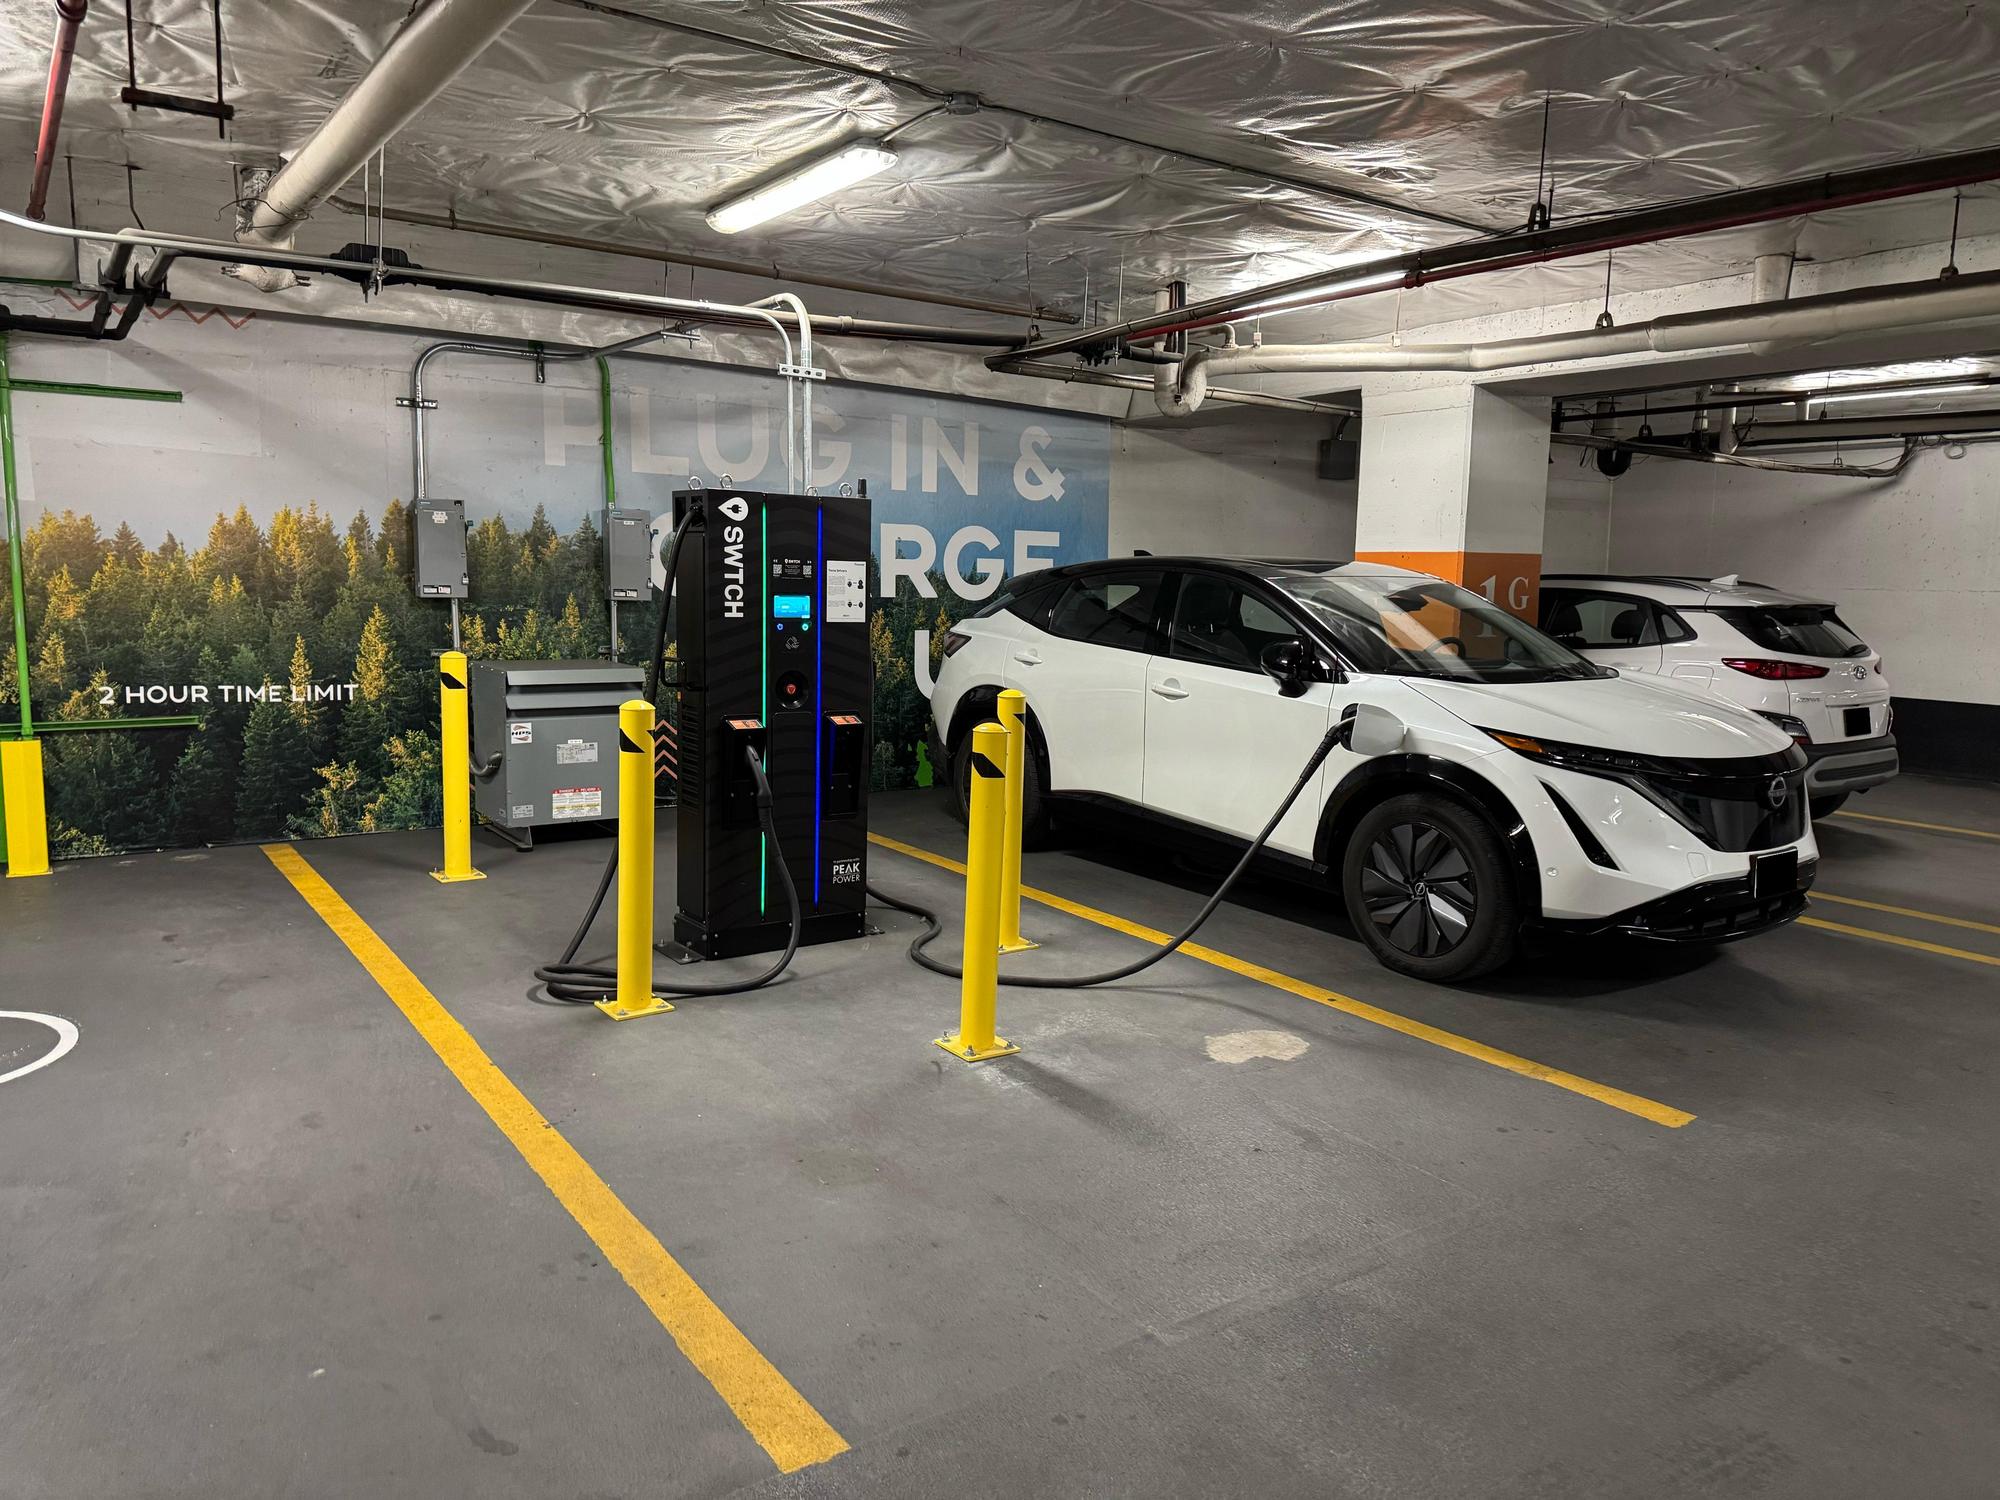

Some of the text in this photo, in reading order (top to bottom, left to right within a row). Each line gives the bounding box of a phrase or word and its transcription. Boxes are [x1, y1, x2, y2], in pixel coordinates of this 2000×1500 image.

[543, 386, 1066, 502] PLUG IN &
[723, 525, 744, 618] SWTCH
[99, 684, 359, 705] 2 HOUR TIME LIMIT
[833, 862, 860, 875] PEAK
[833, 874, 860, 884] POWER
